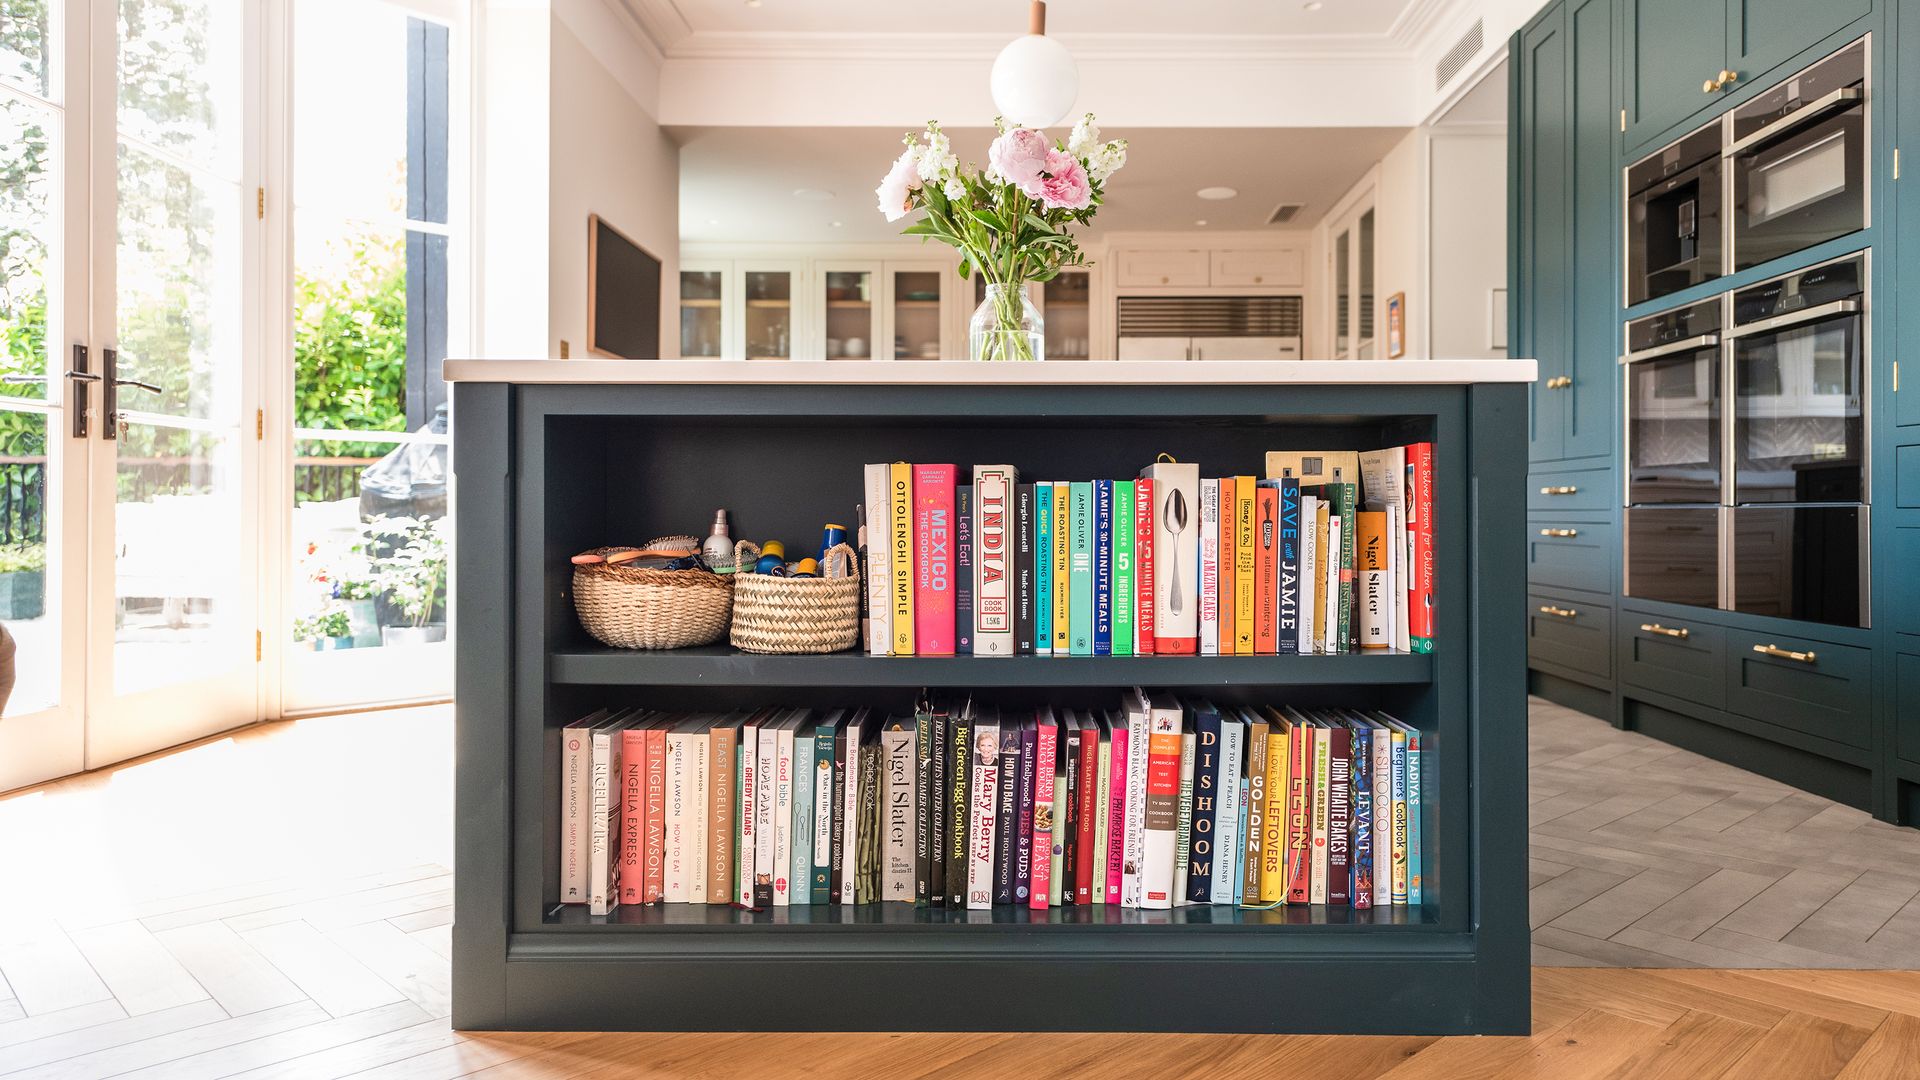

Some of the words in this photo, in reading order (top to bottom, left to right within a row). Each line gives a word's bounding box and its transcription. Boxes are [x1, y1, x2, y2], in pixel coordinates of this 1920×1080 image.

[1422, 450, 1430, 467] The
[1423, 470, 1431, 498] Silver
[897, 481, 906, 563] OTTOLENGHI
[921, 511, 929, 531] THE
[1020, 493, 1028, 520] Giorgio
[1099, 486, 1108, 529] JAMIE'S
[1138, 485, 1151, 536] JAMIE'S
[1224, 513, 1230, 524] TO
[1241, 501, 1250, 525] Honey
[1283, 487, 1297, 539] SAVE
[1421, 501, 1431, 529] Spoon
[960, 516, 970, 540] Let's
[983, 496, 1003, 585] INDIA
[1422, 532, 1431, 549] for
[921, 531, 929, 588] COOKBOOK
[931, 509, 947, 591] MEXICO
[960, 544, 970, 566] Eat!
[1073, 553, 1089, 572] ONE
[1099, 531, 1108, 591] 30-MINUTE
[1118, 553, 1129, 570] 5
[1365, 535, 1380, 571] Nigel
[1141, 562, 1152, 597] MINUTE
[1203, 560, 1216, 595] AMAZING
[1424, 550, 1432, 589] Children
[872, 552, 887, 625] PLENTY
[898, 571, 907, 616] SIMPLE
[1021, 586, 1028, 595] at
[1118, 575, 1128, 624] INGREDIENTS
[1281, 561, 1296, 630] JAMIE
[1368, 572, 1379, 615] Slater
[1099, 594, 1108, 633] MEALS
[1141, 601, 1153, 631] MEALS
[1203, 596, 1216, 621] CAKES
[920, 720, 928, 745] DELIA
[935, 720, 943, 748] DELIA
[956, 727, 968, 745] Big
[1132, 723, 1141, 757] RAYMOND
[1229, 732, 1237, 750] HOW
[674, 741, 682, 776] NIGELLA
[717, 737, 727, 769] FEAST
[886, 738, 909, 787] Nigel
[955, 747, 966, 781] Green
[1025, 742, 1033, 759] Paul
[1039, 741, 1047, 765] LUCY
[1046, 734, 1055, 764] MARY
[1228, 752, 1235, 762] TO
[761, 757, 771, 790] HOME
[779, 757, 789, 781] food
[799, 747, 808, 793] FRANCES
[836, 771, 844, 781] the
[848, 749, 856, 791] Breadmaker
[865, 753, 876, 783] recipe
[974, 767, 982, 793] Cooks
[1004, 757, 1015, 778] HOW
[1068, 759, 1076, 790] wagamama
[1130, 757, 1139, 779] BLANC
[1270, 754, 1279, 779] LOVE
[1332, 757, 1348, 782] JOHN
[1392, 747, 1405, 798] Beginner's
[1409, 757, 1419, 805] NADIYA'S
[627, 764, 638, 813] NIGELLA
[650, 759, 660, 813] NIGELLA
[744, 767, 753, 798] GREEDY
[778, 784, 788, 807] bible
[866, 785, 876, 810] book
[919, 770, 927, 805] SUMMER
[934, 780, 943, 808] WINTER
[954, 781, 966, 803] Egg
[980, 768, 996, 811] Mary
[1004, 780, 1014, 793] TO
[1022, 760, 1032, 807] Hollywood's
[1037, 767, 1046, 798] YOUNG
[1045, 767, 1054, 799] BERRY
[1129, 780, 1138, 814] COOKING
[1270, 781, 1278, 799] YOUR
[717, 774, 726, 823] NIGELLA
[847, 793, 855, 811] Bible
[973, 795, 981, 808] the
[1002, 796, 1014, 814] BAKE
[1191, 731, 1216, 876] DISHOOM
[1249, 776, 1263, 852] GOLDEN
[1291, 777, 1309, 850] LEON
[1331, 784, 1347, 820] WHAITE
[744, 800, 752, 836] ITALIANS
[832, 822, 843, 842] bakery
[891, 792, 910, 848] Slater
[918, 807, 926, 858] COLLECTION
[954, 804, 965, 859] Cookbook
[972, 810, 980, 841] Perfect
[1020, 810, 1030, 835] PIES
[1128, 815, 1137, 828] FOR
[1358, 791, 1370, 853] LEVANT
[1395, 801, 1406, 848] Cookbook
[569, 823, 577, 846] SIMPLY
[626, 818, 637, 866] EXPRESS
[649, 819, 660, 878] LAWSON
[934, 810, 942, 863] COLLECTION
[977, 815, 995, 863] Berry
[1019, 837, 1028, 846] &
[1127, 830, 1136, 857] FRIENDS
[1266, 800, 1280, 873] LEFTOVERS
[1330, 822, 1347, 853] BAKES
[569, 850, 577, 879] NIGELLA
[673, 847, 680, 858] TO
[716, 829, 726, 881] LAWSON
[833, 844, 842, 871] cookbook
[1001, 837, 1010, 885] HOLLYWOOD
[1018, 848, 1028, 879] PUDS
[1034, 837, 1045, 881] FEAST
[1043, 862, 1050, 873] UP
[796, 856, 805, 891] QUINN
